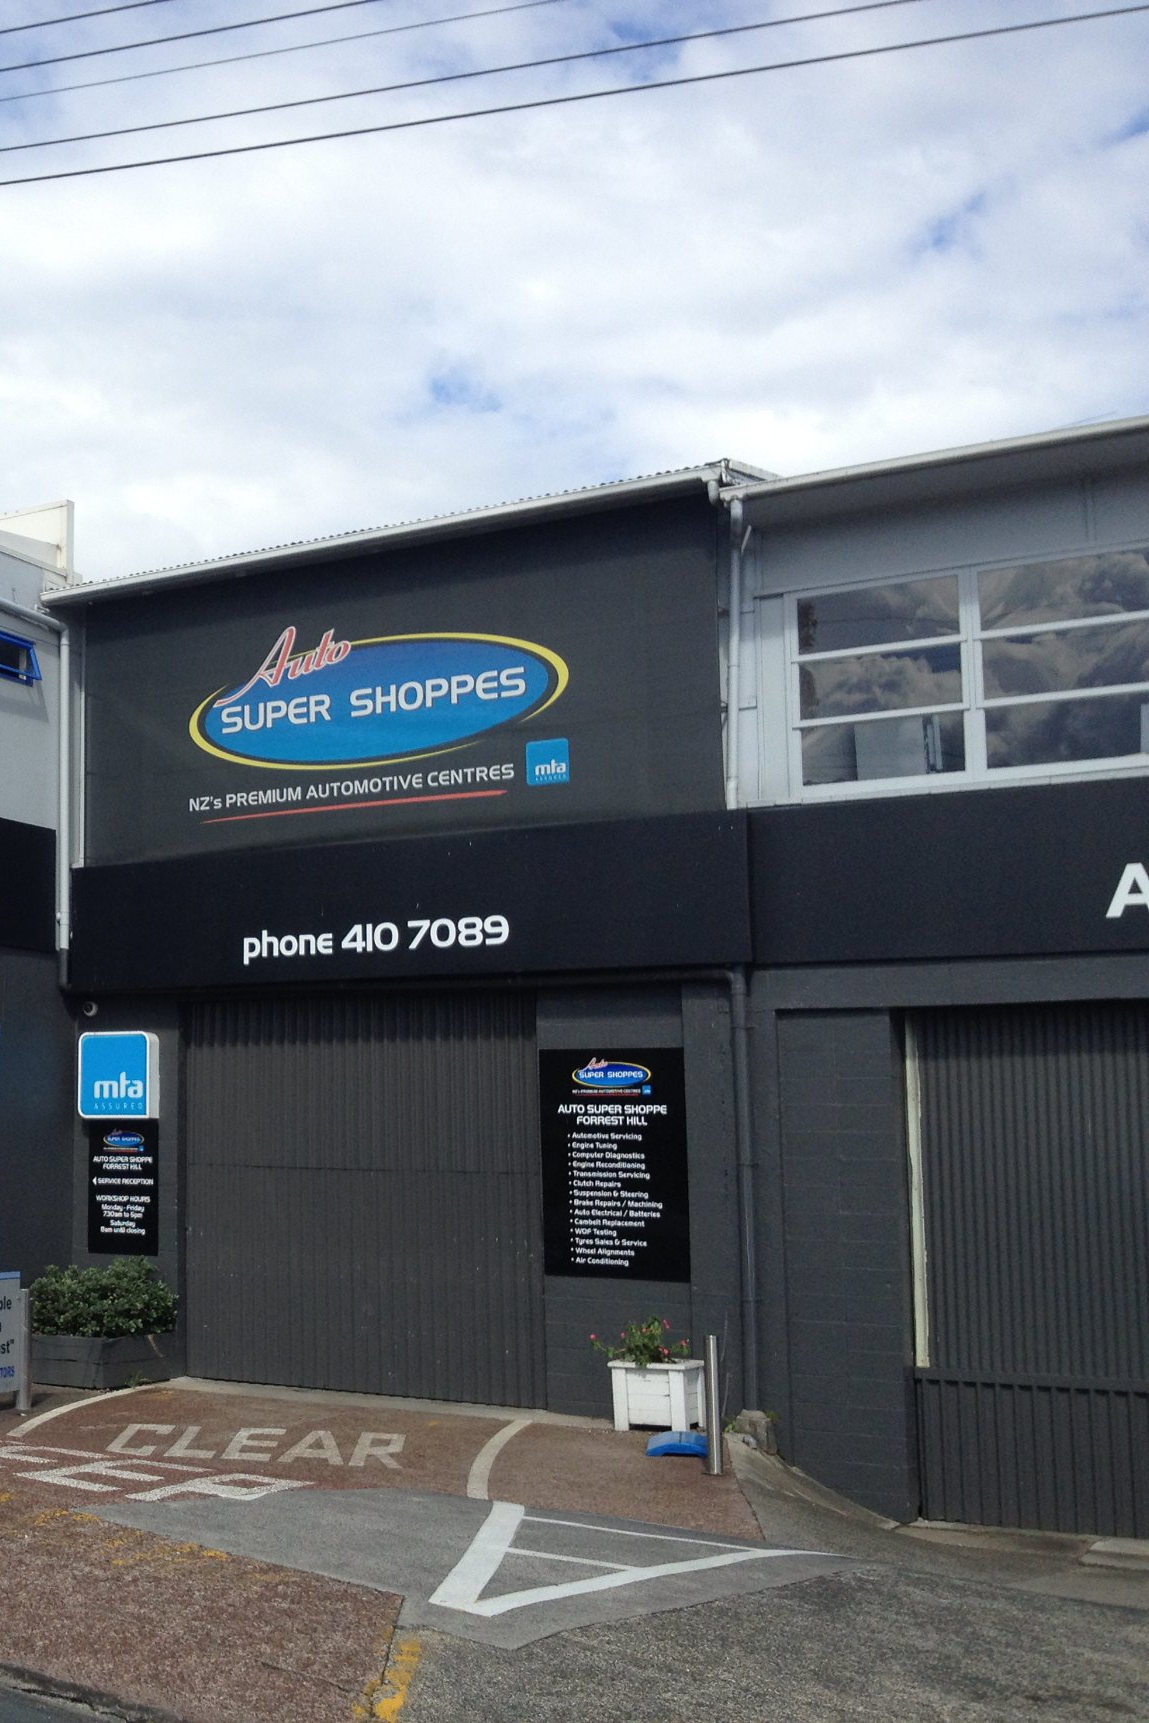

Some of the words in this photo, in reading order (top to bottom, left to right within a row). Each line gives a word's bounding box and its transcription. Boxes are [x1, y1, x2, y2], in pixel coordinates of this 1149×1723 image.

[213, 626, 351, 708] Auto
[220, 694, 331, 734] SUPER
[350, 666, 527, 718] SHOPPES
[535, 759, 567, 775] mta
[188, 796, 222, 812] NZ's
[225, 786, 302, 808] PREMIUM
[305, 773, 423, 800] AUTOMOTIVE
[427, 763, 515, 787] CENTRES
[243, 929, 333, 965] phone
[341, 921, 399, 953] 410
[407, 914, 510, 950] 7089
[607, 1070, 643, 1078] SHOPPES
[94, 1071, 144, 1099] mta
[94, 1102, 143, 1110] ASSURED
[557, 1104, 585, 1114] AUTO
[587, 1104, 622, 1114] SUPER
[624, 1104, 668, 1115] SHOPPE
[576, 1115, 624, 1125] FORREST
[627, 1116, 648, 1126] HILL
[610, 1132, 642, 1141] Servicing
[572, 1142, 594, 1150] Engine
[595, 1142, 617, 1150] Tuning
[93, 1155, 109, 1163] AUTO
[109, 1155, 128, 1163] SUPER
[129, 1156, 153, 1164] SHOPPE
[572, 1151, 604, 1159] Computer
[605, 1151, 645, 1160] Diagnostics
[572, 1161, 594, 1169] Engine
[596, 1161, 645, 1170] Reconditioning
[573, 1170, 617, 1178] Transmission
[618, 1171, 650, 1180] Servicing
[97, 1177, 121, 1185] SERVICE
[122, 1178, 154, 1186] RECEPTION
[595, 1180, 621, 1188] Repairs
[573, 1189, 612, 1198] Suspension
[620, 1190, 649, 1199] Steering
[101, 1203, 123, 1212] Monday
[126, 1204, 145, 1212] Friday
[573, 1199, 594, 1207] Brake
[595, 1200, 621, 1208] Repairs
[627, 1201, 663, 1209] Machining
[591, 1209, 622, 1217] Electrical
[629, 1210, 661, 1218] Batteries
[110, 1219, 136, 1228] Saturday
[574, 1218, 601, 1226] Cambelt
[602, 1219, 645, 1227] Replacement
[126, 1227, 145, 1235] closing
[593, 1228, 617, 1237] Testing
[575, 1237, 593, 1246] Tyres
[621, 1239, 647, 1247] Service
[597, 1247, 635, 1256] Alignments
[575, 1256, 586, 1264] Air
[587, 1257, 629, 1267] Conditioning
[110, 1423, 406, 1470] CLEAR
